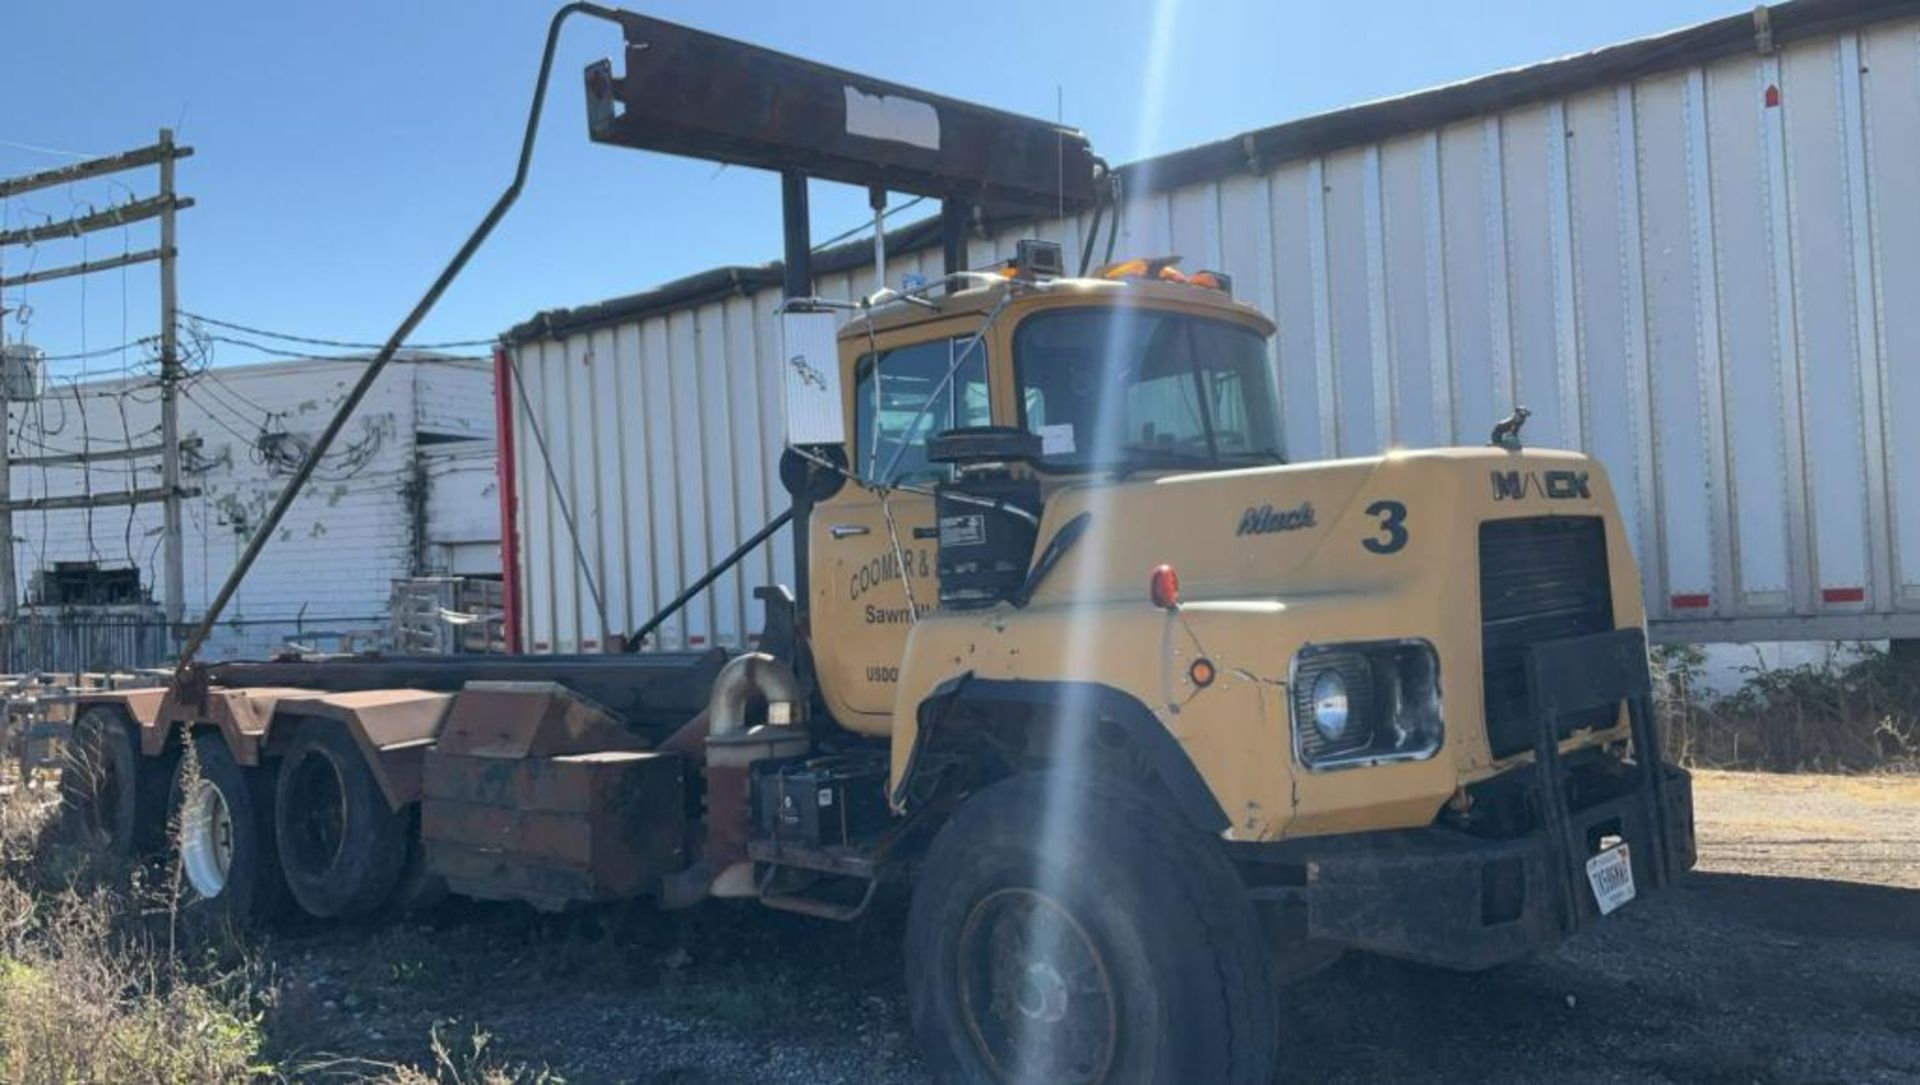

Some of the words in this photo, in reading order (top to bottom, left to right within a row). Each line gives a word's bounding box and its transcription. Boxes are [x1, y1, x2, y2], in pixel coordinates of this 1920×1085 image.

[1490, 470, 1591, 501] MACK
[1236, 501, 1316, 536] Mack
[1361, 500, 1408, 554] 3
[850, 549, 914, 601] COOMER
[919, 549, 929, 578] &
